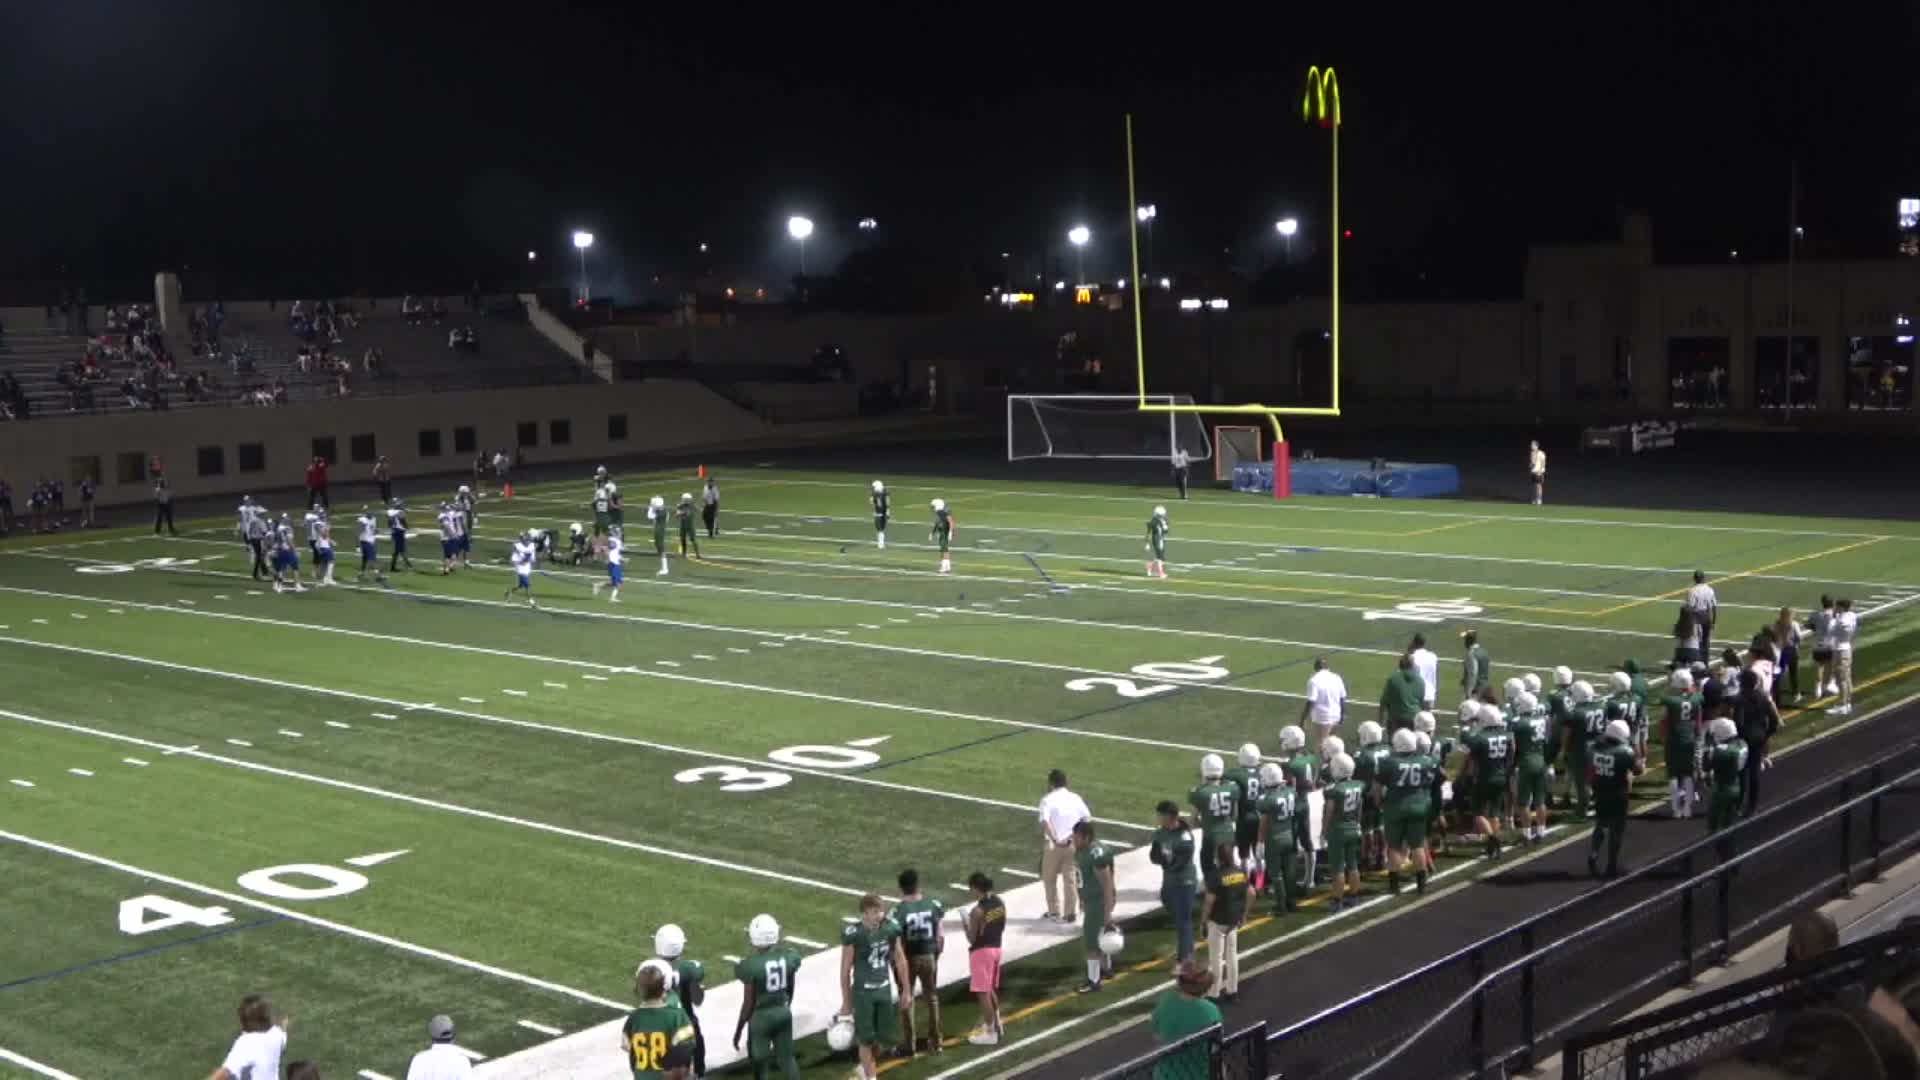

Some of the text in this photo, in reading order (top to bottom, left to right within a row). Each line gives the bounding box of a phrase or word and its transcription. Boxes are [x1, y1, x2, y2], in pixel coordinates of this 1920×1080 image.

[1362, 601, 1484, 622] 10
[1065, 662, 1230, 698] 20
[1487, 735, 1507, 759] 55
[674, 744, 880, 792] 30
[1397, 762, 1421, 787] 76
[1593, 752, 1616, 777] 52
[1210, 791, 1231, 816] 45
[118, 863, 369, 935] 40
[905, 911, 933, 939] 25
[765, 957, 787, 992] 61
[631, 1031, 668, 1071] 68
